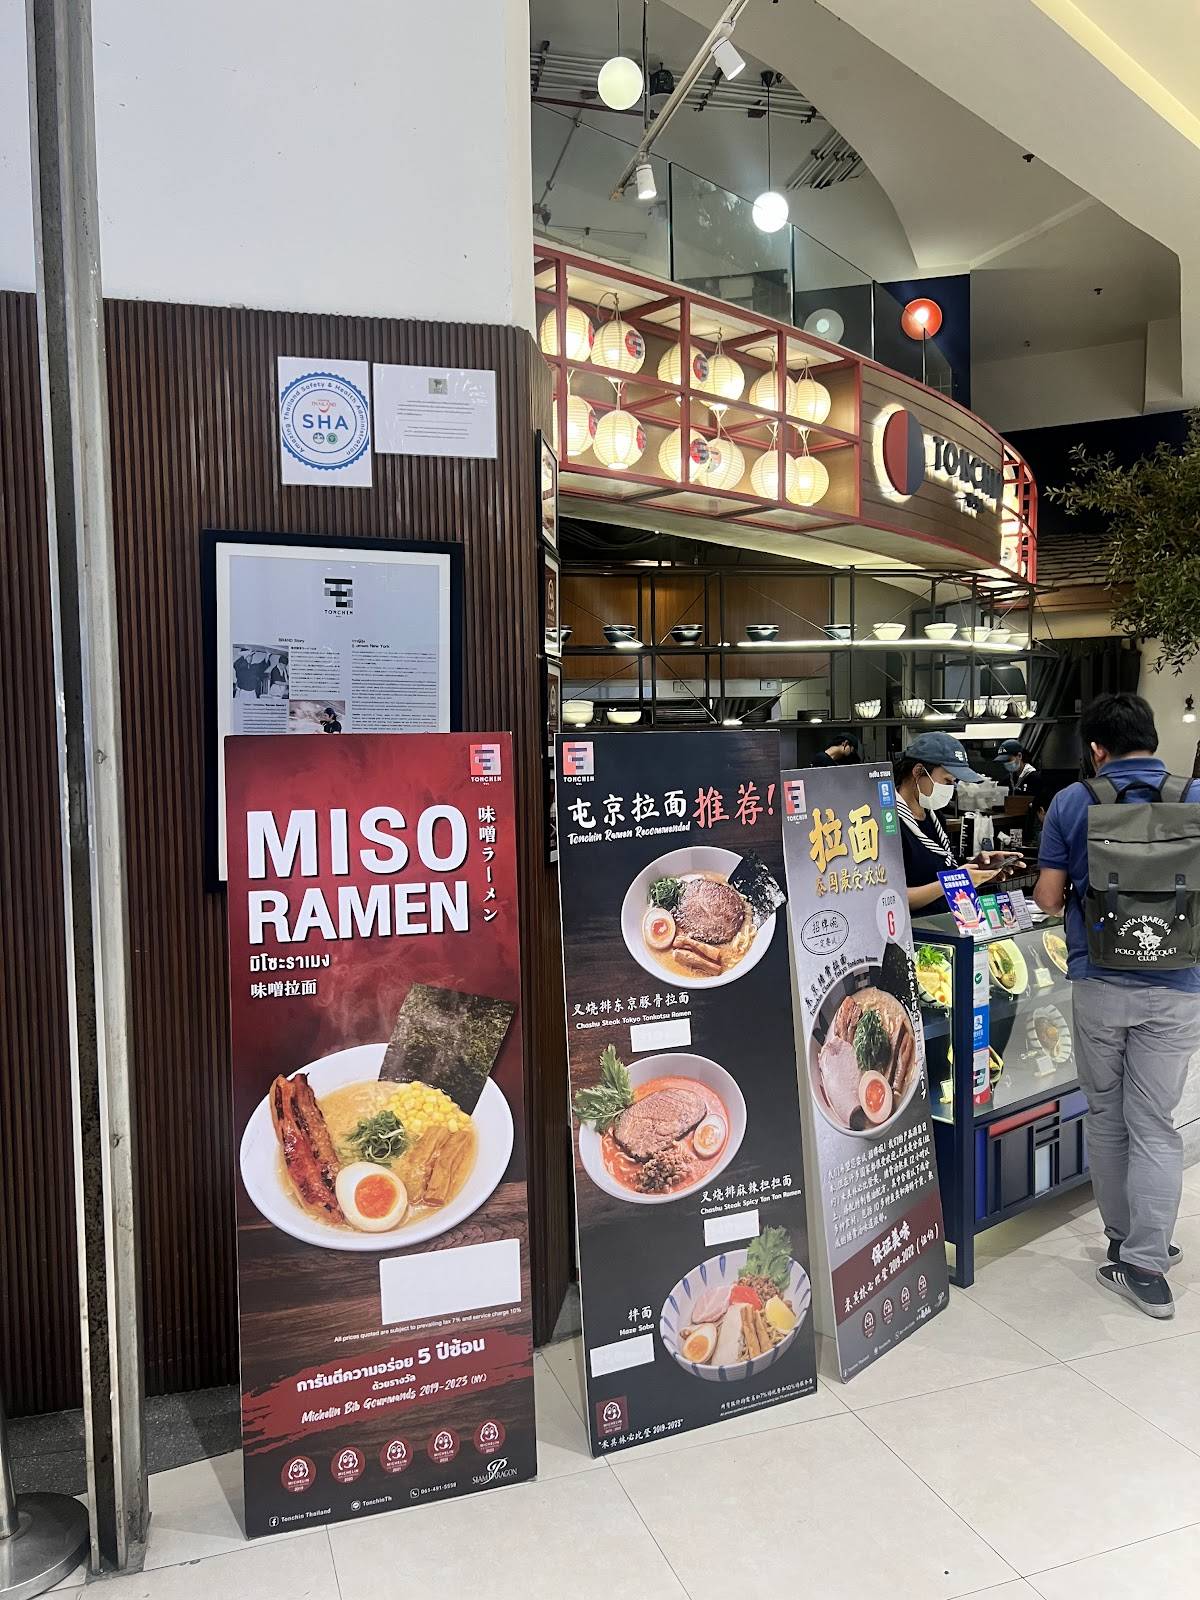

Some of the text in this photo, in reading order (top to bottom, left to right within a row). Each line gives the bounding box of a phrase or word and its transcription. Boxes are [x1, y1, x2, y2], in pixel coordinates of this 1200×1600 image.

[301, 382, 325, 392] Safety
[335, 385, 357, 403] Health
[284, 390, 301, 420] Thailand
[302, 414, 349, 430] SHA
[346, 404, 366, 455] Administration
[286, 424, 305, 453] Amazing
[246, 804, 468, 880] MISO
[568, 821, 691, 845] Tonchin Ramen Recommended
[808, 804, 880, 874] 拉面
[478, 806, 498, 922] 味噌ラーメン
[815, 864, 888, 898] 泰国最受欢迎
[248, 880, 469, 945] RAMEN
[887, 910, 896, 936] G
[1118, 915, 1172, 936] SANTA BARBARA
[250, 953, 330, 972] มิโซะราเมง
[1115, 948, 1135, 956] POLO
[1144, 947, 1177, 957] RACQUET
[250, 979, 317, 999] 味噌拉面
[572, 992, 690, 1017] 叉烧排东京豚骨拉面
[576, 1021, 600, 1030] Chashu
[602, 1019, 621, 1027] Steak
[701, 1174, 792, 1203] 叉烧排麻辣担担面
[700, 1206, 723, 1215] Chashu
[724, 1201, 741, 1210] Steak
[743, 1198, 759, 1207] Spicy
[783, 1190, 802, 1198] Ramen
[872, 1220, 911, 1267] 保证美味
[342, 1334, 360, 1342] prices
[360, 1330, 379, 1340] quoted
[390, 1325, 410, 1334] subject
[416, 1320, 442, 1331] prevailing
[452, 1316, 462, 1324] 7%
[462, 1314, 472, 1322] and
[472, 1312, 491, 1320] service
[492, 1309, 510, 1319] charge
[510, 1307, 522, 1315] 10%
[628, 1306, 653, 1322] 拌面
[620, 1322, 655, 1336] Maze Soba
[297, 1338, 486, 1393] การันตีความอร่อย 5 ปีซ้อน
[372, 1373, 417, 1391] ด้วยรางวัล
[302, 1405, 341, 1424] Michelin
[344, 1400, 361, 1415] Bib
[364, 1388, 417, 1410] Gourmands
[419, 1375, 468, 1397] 2019-2023
[363, 1496, 393, 1508] TonchinTh
[282, 1508, 332, 1523] Tonchin Thailand
